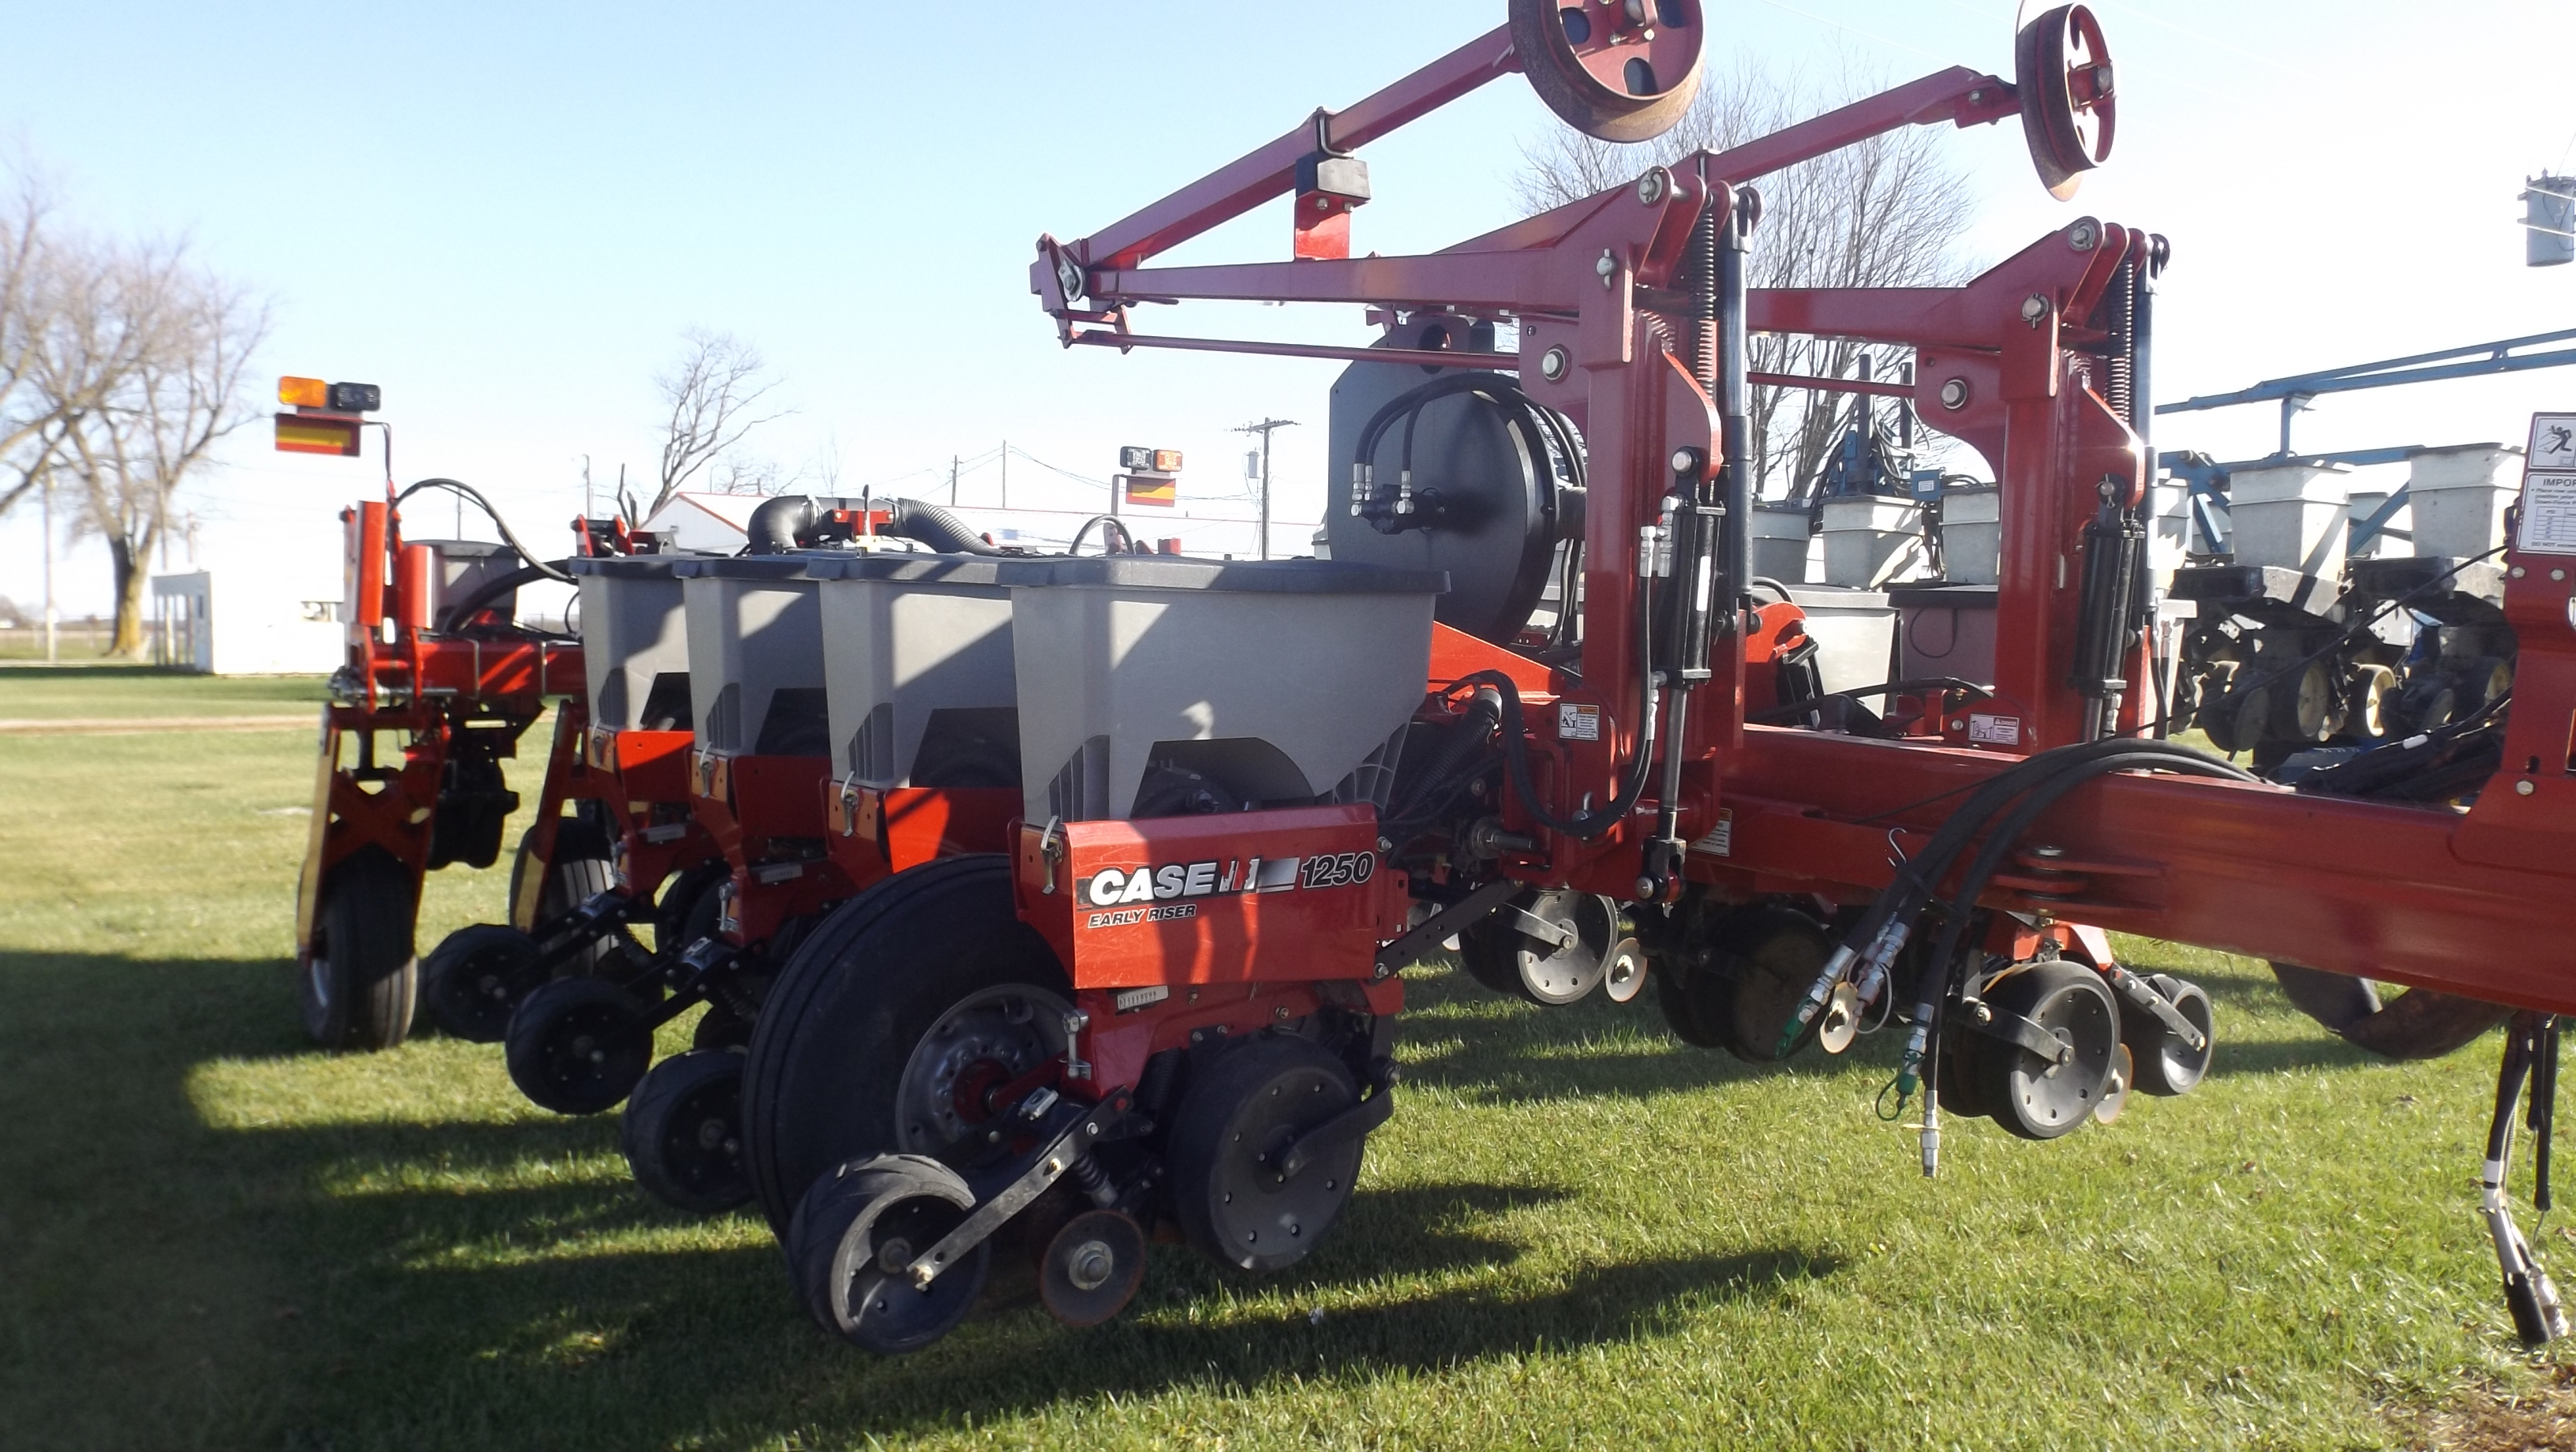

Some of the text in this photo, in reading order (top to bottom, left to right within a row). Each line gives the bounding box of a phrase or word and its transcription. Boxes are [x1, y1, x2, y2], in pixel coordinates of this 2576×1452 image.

[1088, 862, 1218, 907] CASE
[1301, 851, 1376, 889] 1250
[1088, 904, 1197, 930] EARLY RISER
